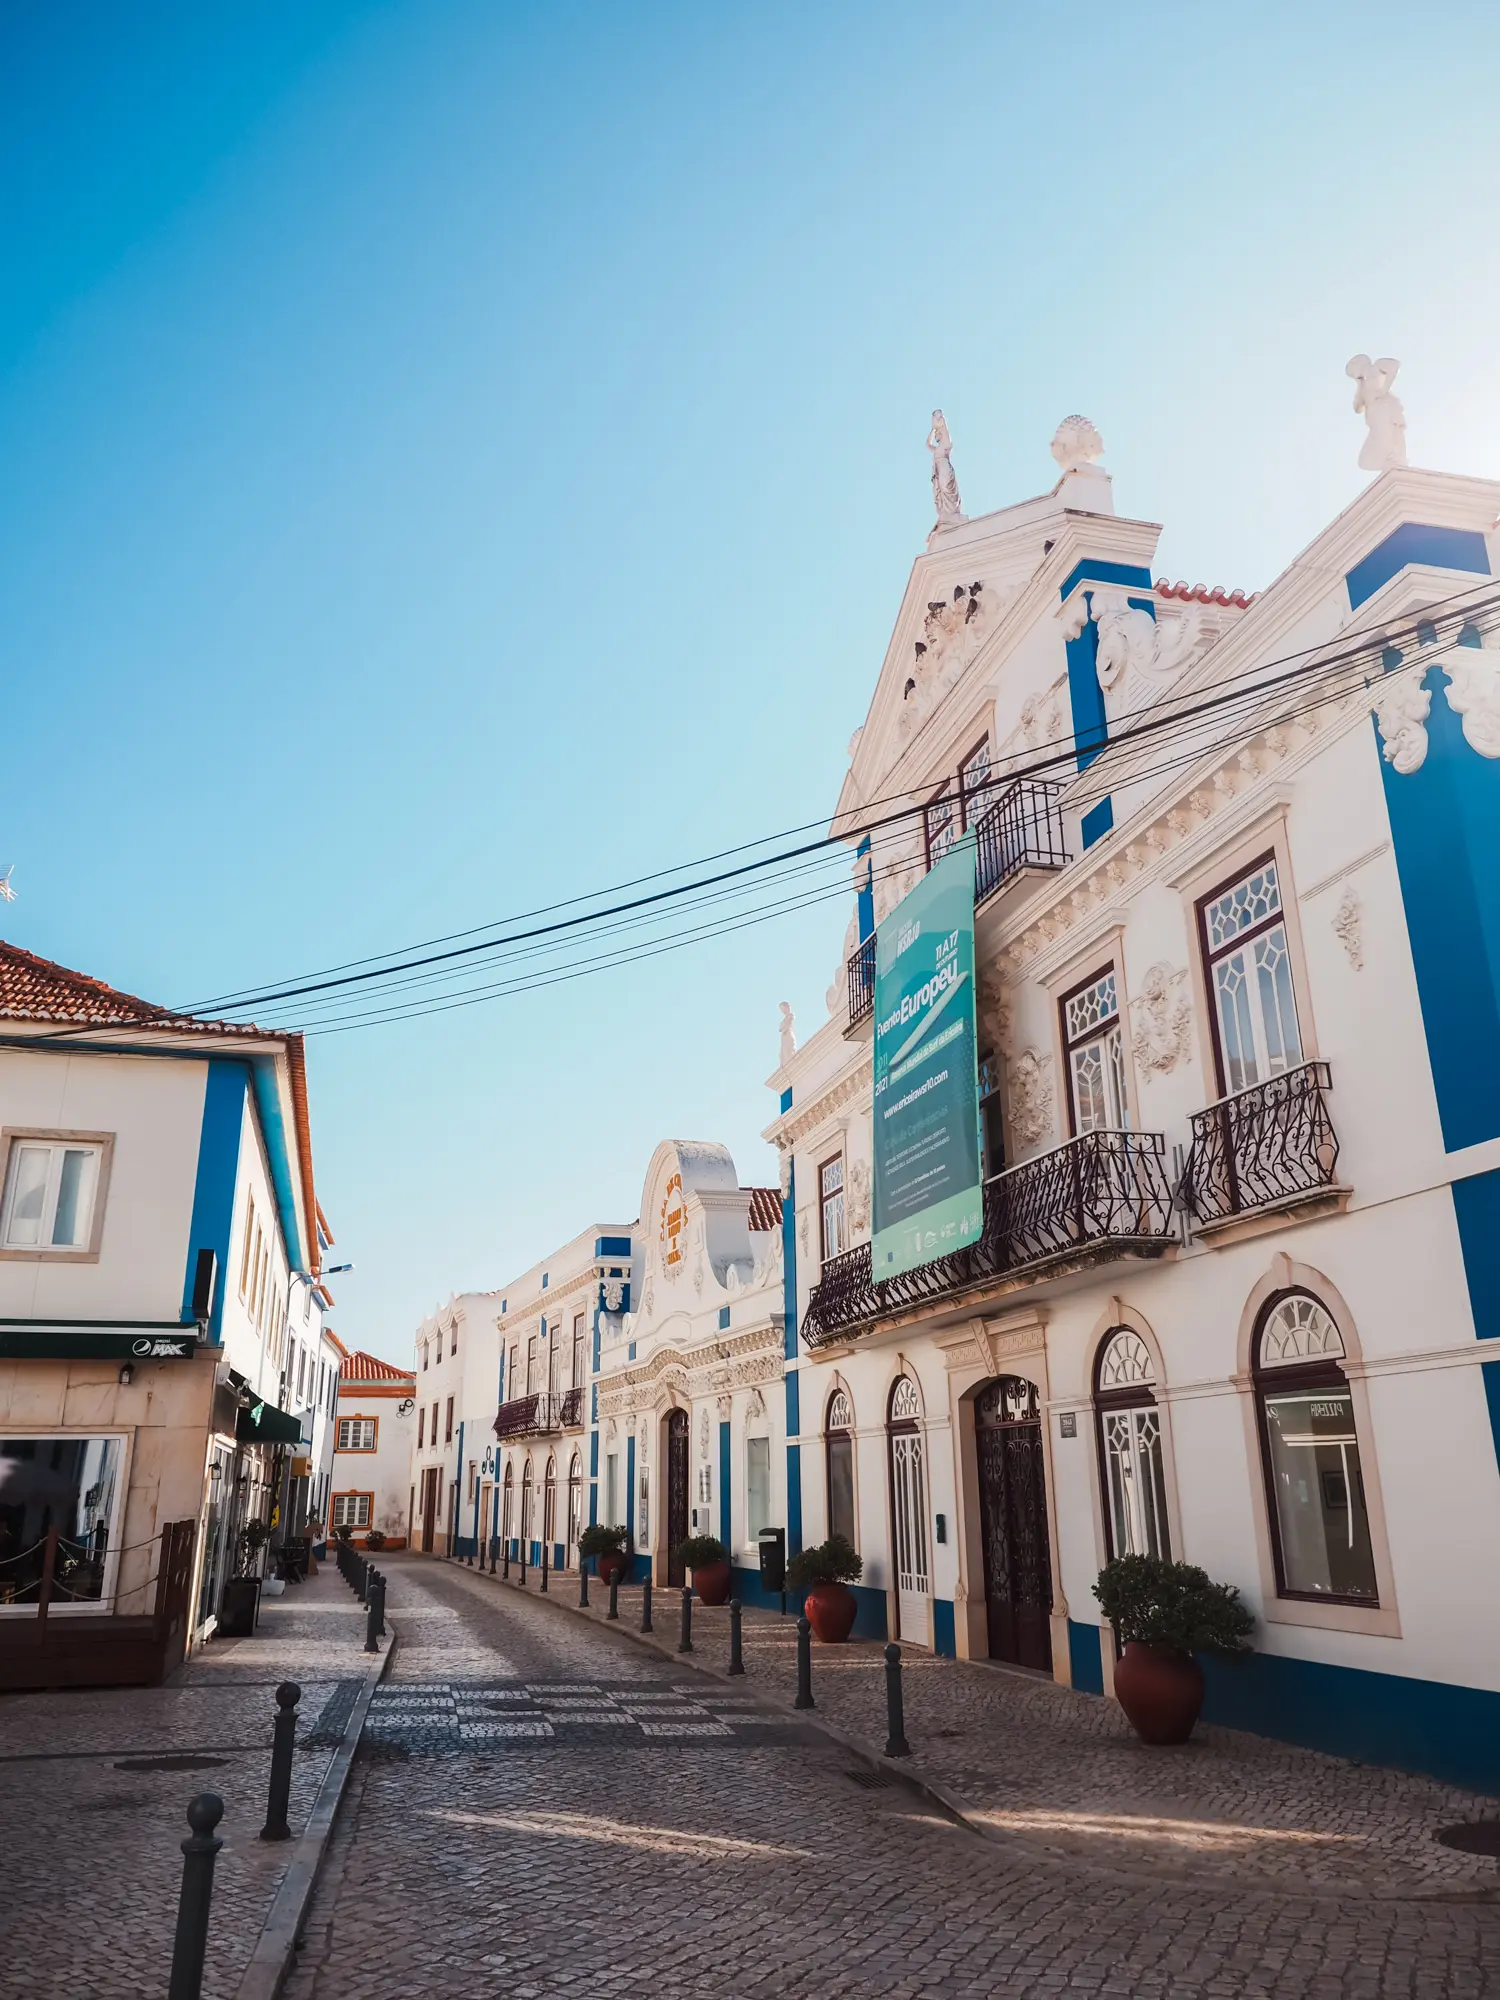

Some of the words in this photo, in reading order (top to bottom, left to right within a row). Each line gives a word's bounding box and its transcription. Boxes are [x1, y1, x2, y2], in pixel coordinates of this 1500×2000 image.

[877, 1009, 900, 1040] Evento
[900, 958, 958, 1025] Europeu
[928, 1038, 939, 1053] Surf
[875, 1075, 889, 1097] 2021
[883, 1069, 949, 1120] www.ericeirawsr10.com
[150, 1343, 186, 1356] MAX
